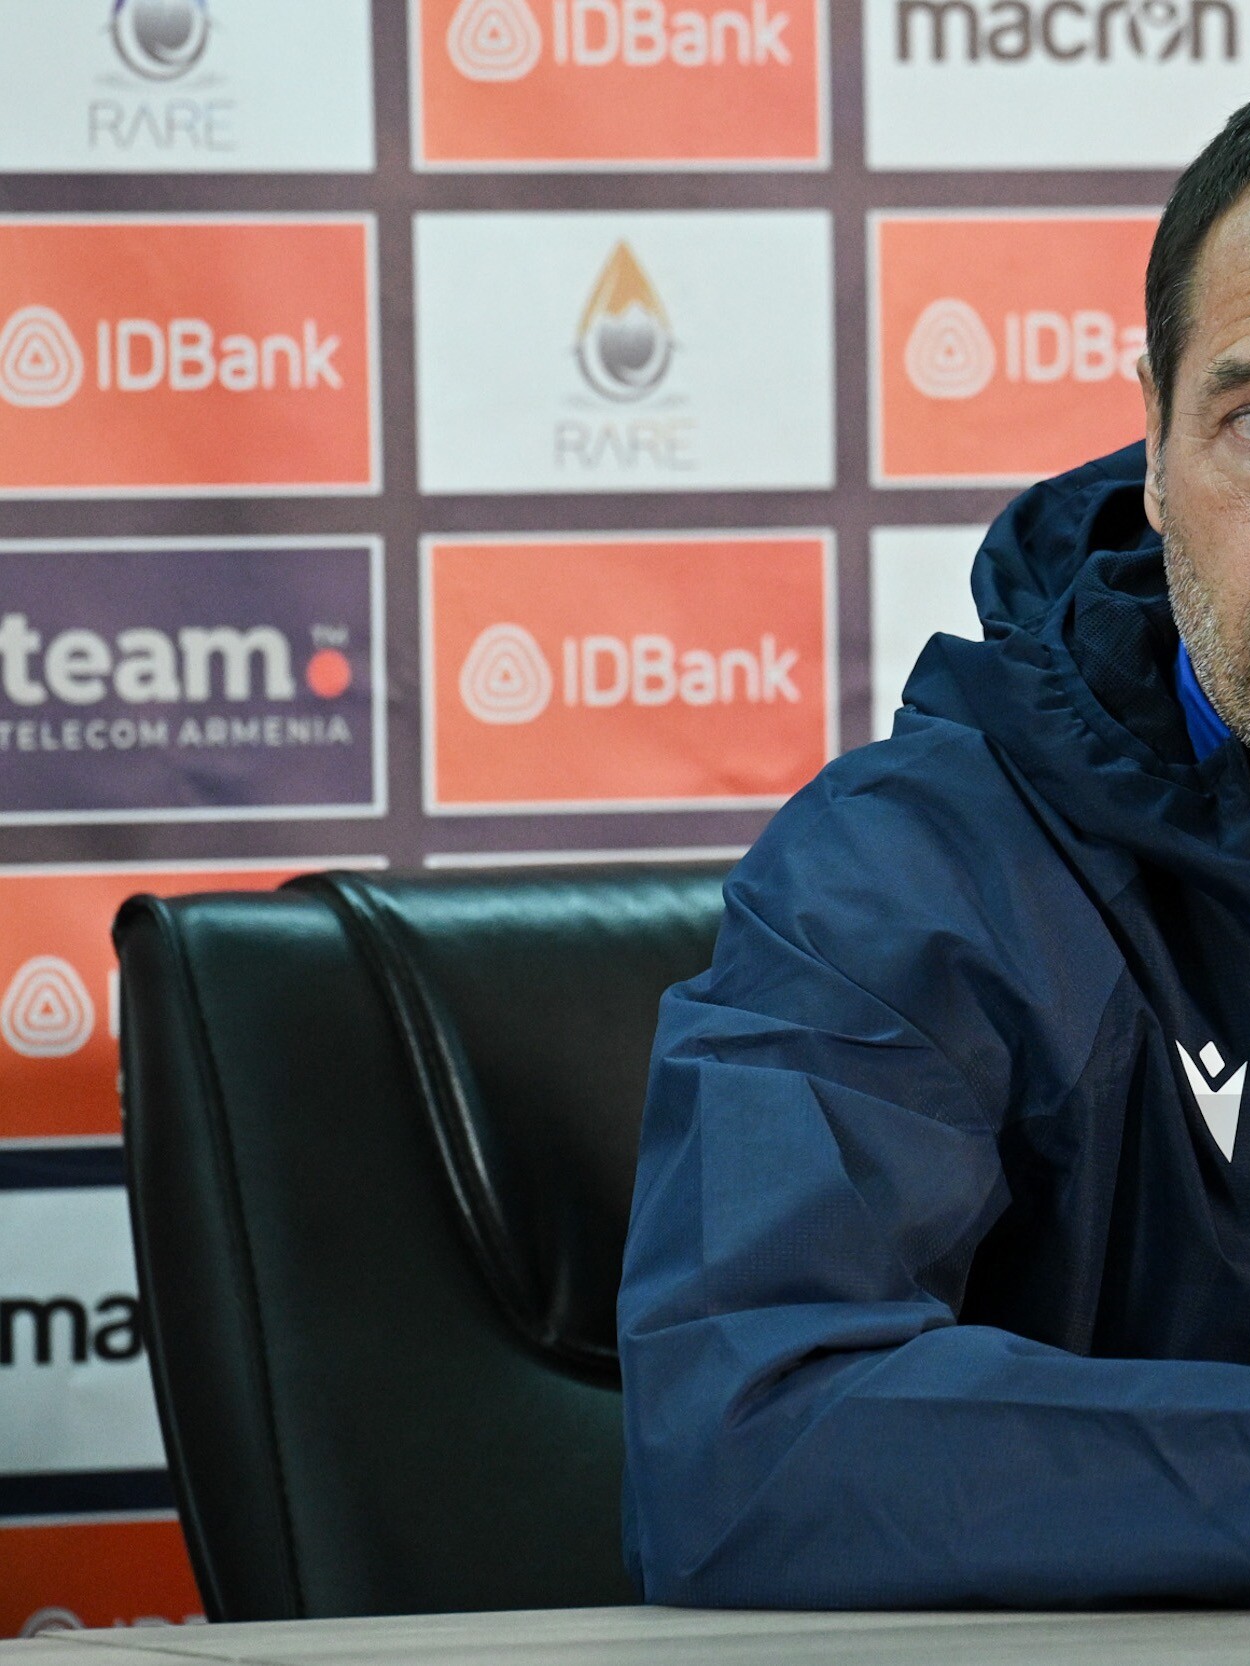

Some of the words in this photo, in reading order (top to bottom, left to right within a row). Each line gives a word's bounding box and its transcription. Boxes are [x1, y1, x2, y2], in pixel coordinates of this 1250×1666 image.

[555, 0, 791, 66] IDBank
[87, 99, 239, 151] RARE
[96, 317, 344, 391] IDBank
[553, 419, 701, 471] RARE
[562, 633, 801, 708] IDBank
[178, 715, 350, 748] ARMENIA
